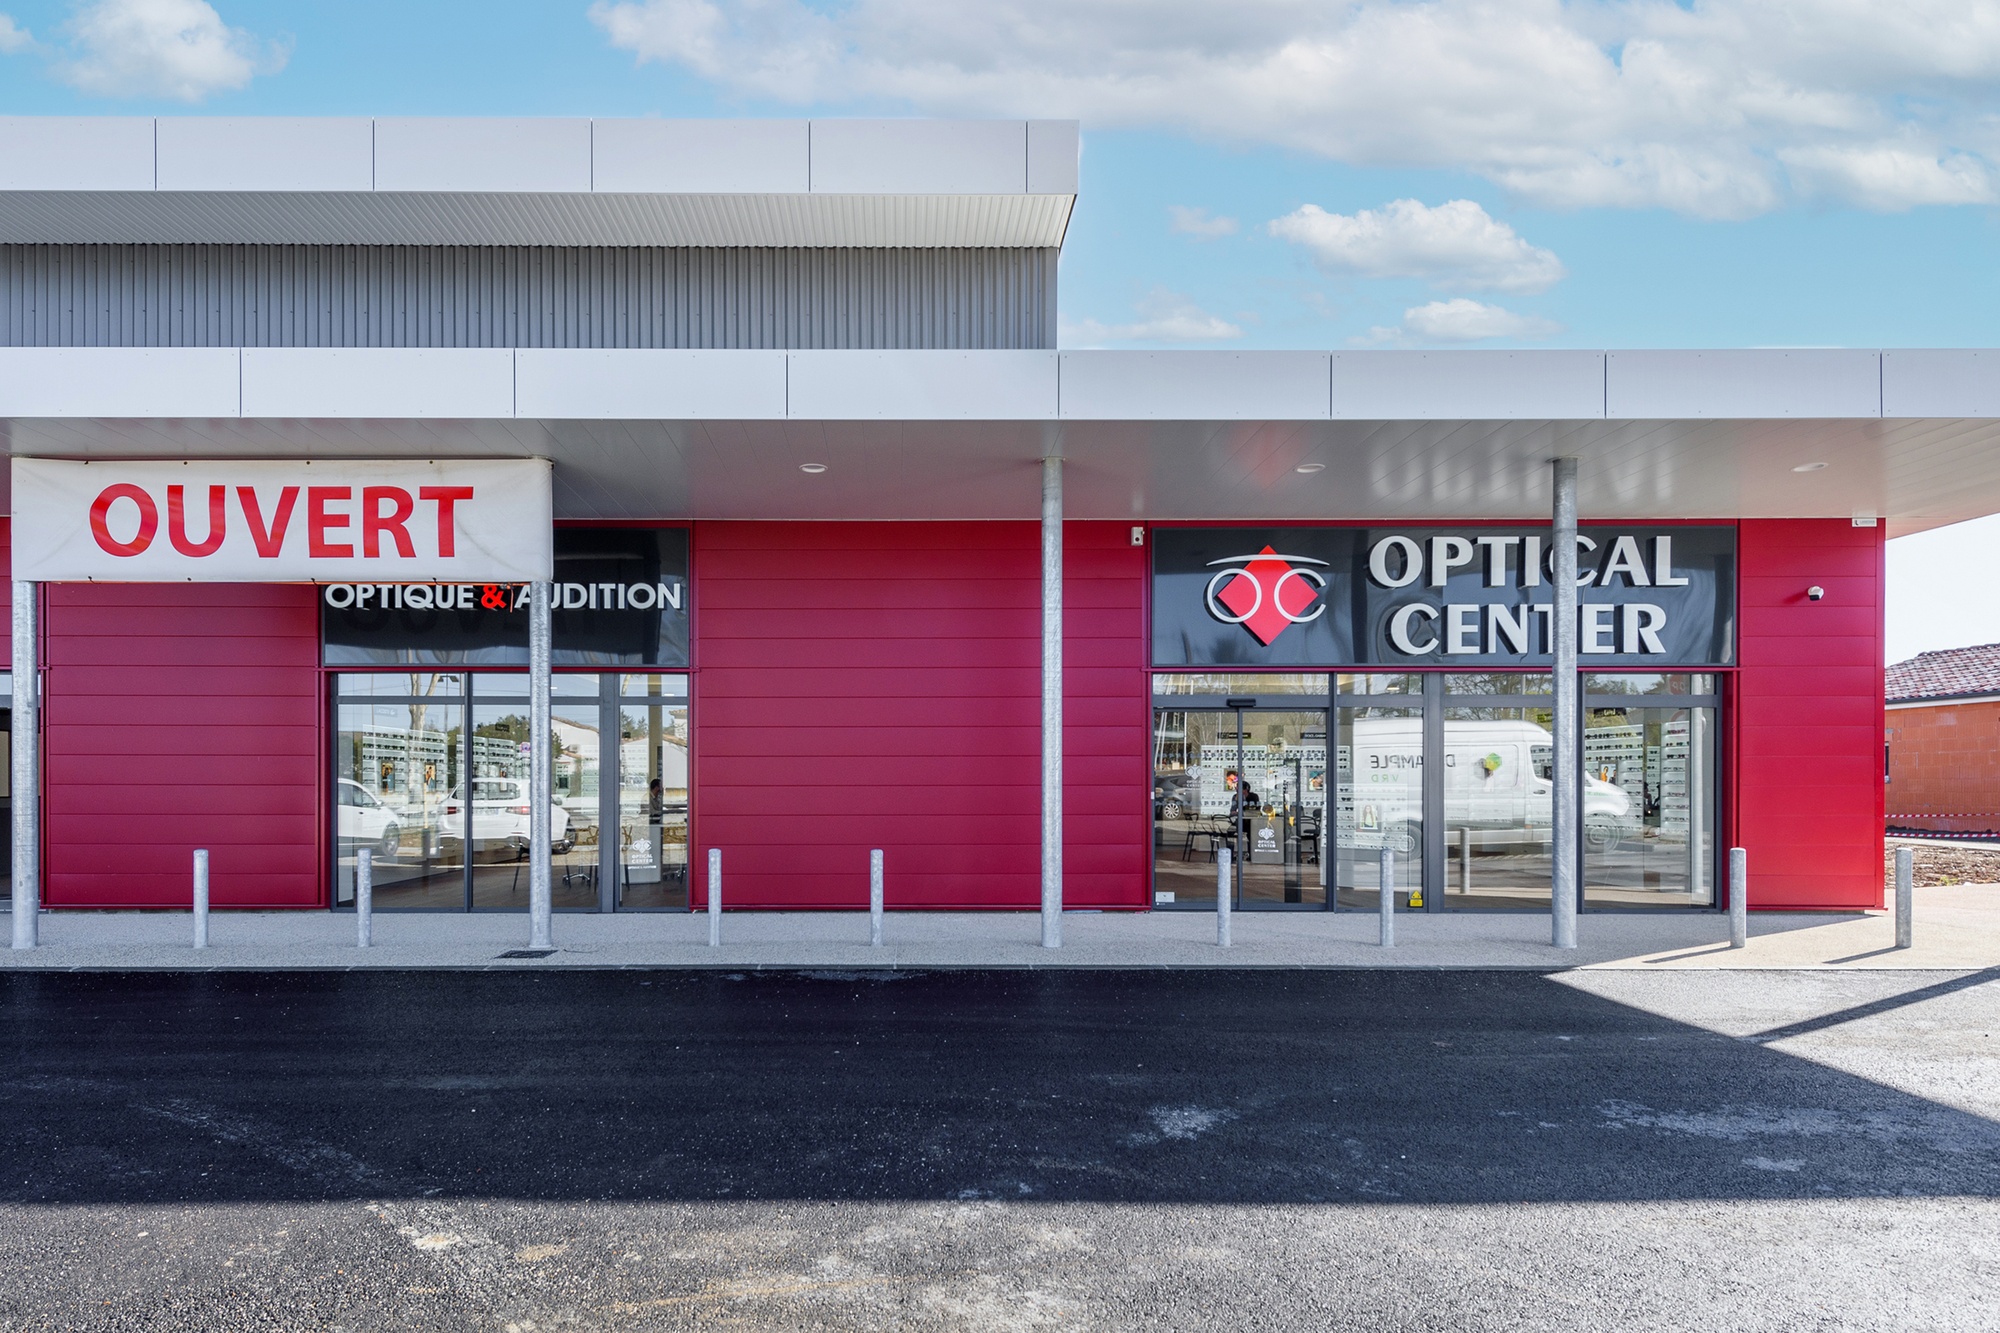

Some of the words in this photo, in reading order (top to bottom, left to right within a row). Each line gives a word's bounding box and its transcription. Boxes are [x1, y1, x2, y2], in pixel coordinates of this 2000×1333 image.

[89, 483, 474, 559] OUVERT
[325, 583, 474, 609] OPTIQUE
[480, 585, 507, 609] &
[514, 582, 681, 609] AUDITION
